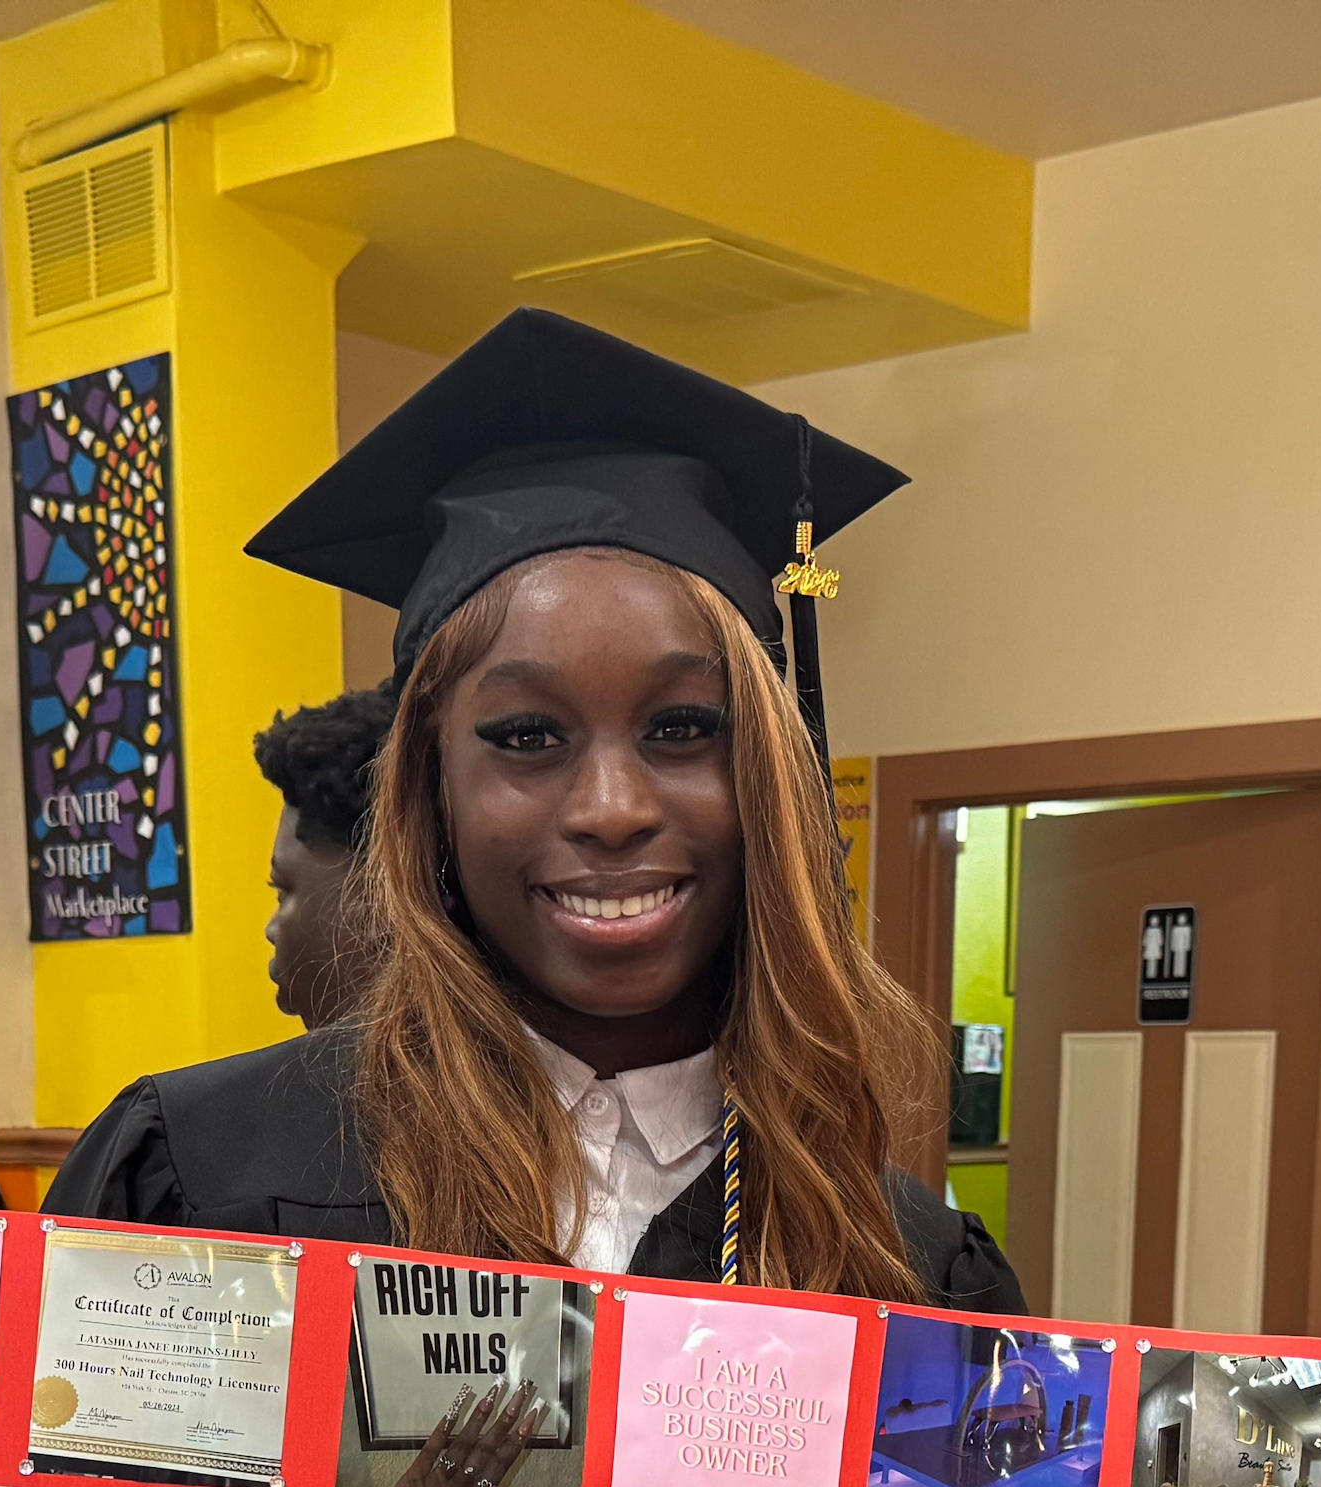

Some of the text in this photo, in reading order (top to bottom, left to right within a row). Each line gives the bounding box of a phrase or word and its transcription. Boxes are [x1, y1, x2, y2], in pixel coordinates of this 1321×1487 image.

[41, 789, 122, 828] CENTER
[43, 841, 113, 879] STREET
[46, 883, 150, 928] Marketplace
[167, 1271, 213, 1285] AVALON
[373, 1264, 532, 1319] RICH OFF
[74, 1295, 154, 1318] Certificate
[159, 1304, 176, 1320] of
[181, 1306, 273, 1329] Completion
[422, 1331, 507, 1375] NAILS
[53, 1359, 76, 1371] 300
[78, 1361, 116, 1376] Hours
[119, 1366, 145, 1380] Nail
[148, 1369, 215, 1389] Technology
[218, 1377, 281, 1394] Licensure
[693, 1357, 788, 1390] I AM A
[641, 1381, 832, 1426] SUCCESSFUL
[662, 1412, 807, 1451] BUSINESS
[678, 1443, 788, 1478] OWNER
